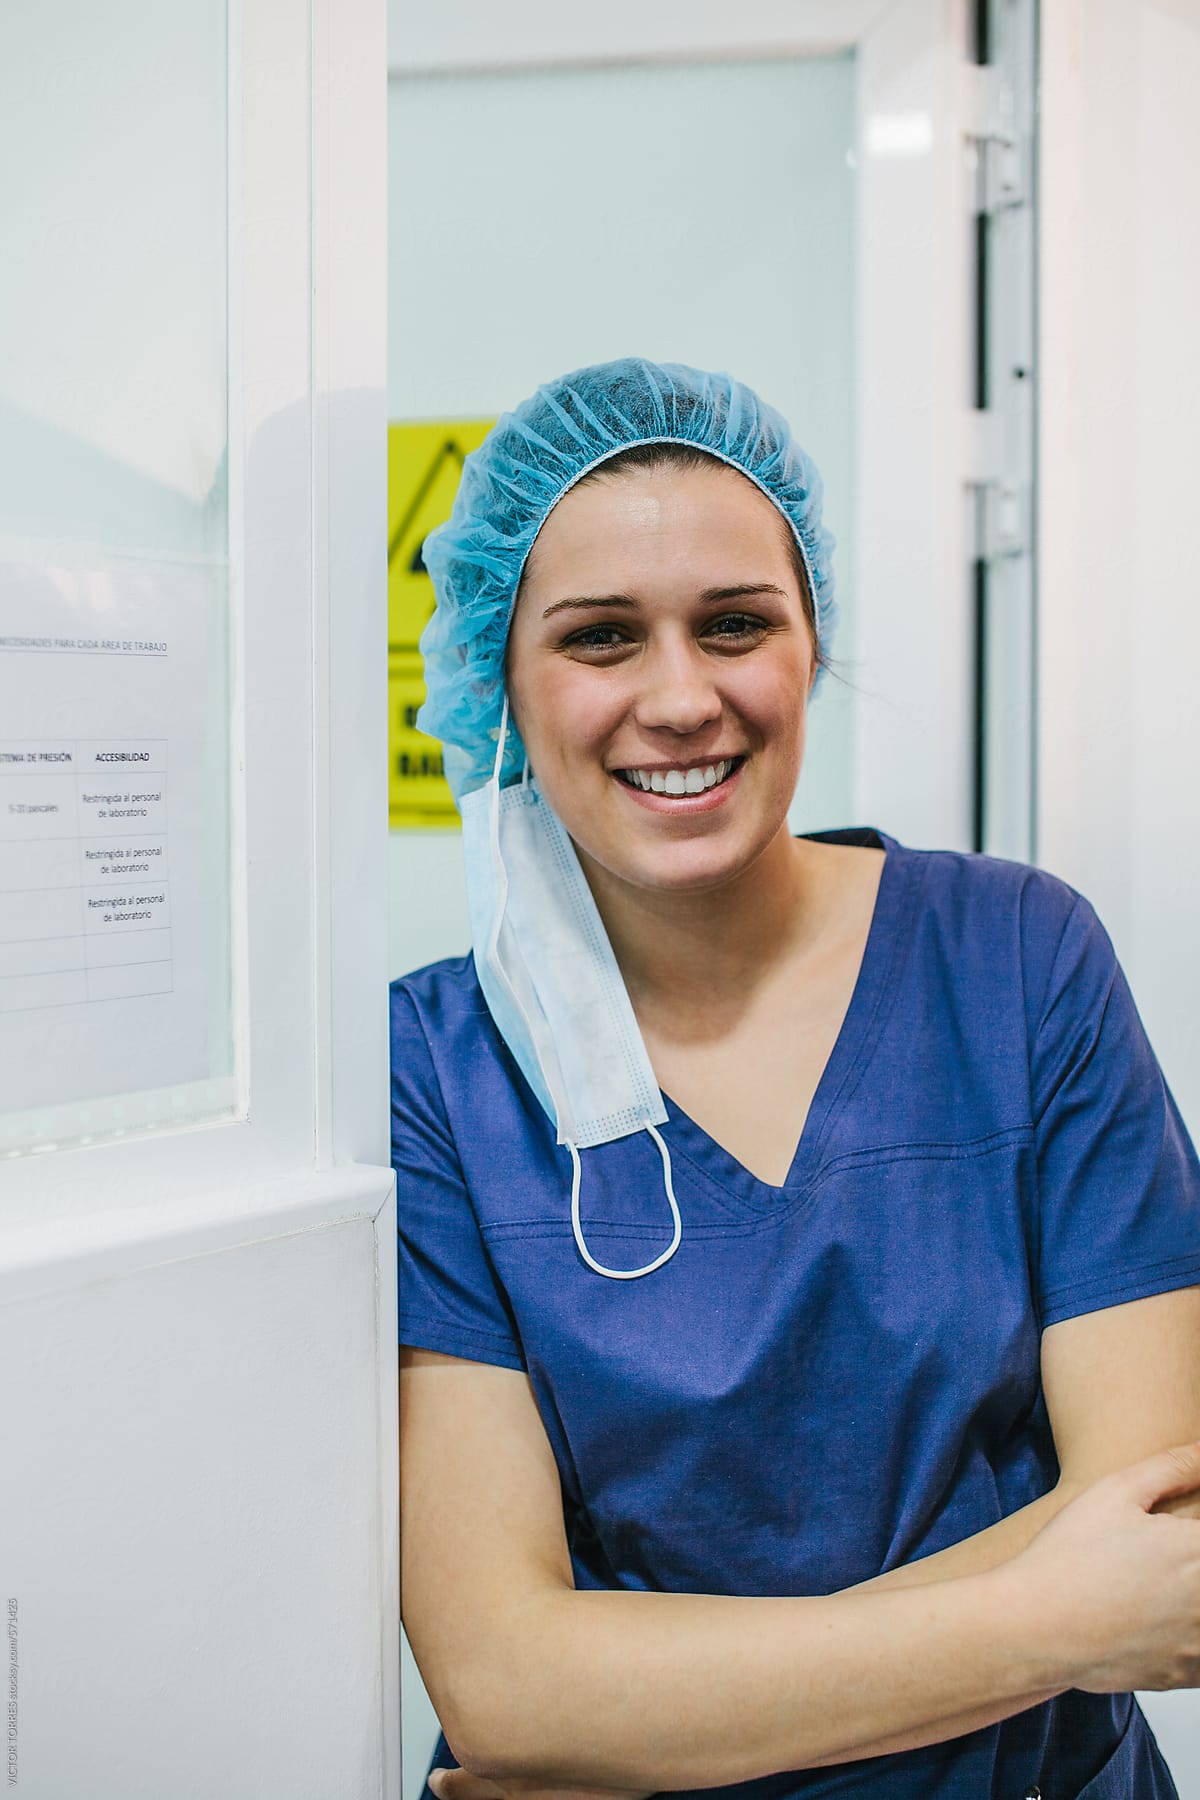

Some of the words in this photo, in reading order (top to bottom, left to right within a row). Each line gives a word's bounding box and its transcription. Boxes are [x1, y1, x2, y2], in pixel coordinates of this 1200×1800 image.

[55, 639, 75, 648] PARA
[77, 639, 99, 649] CADA
[122, 640, 133, 651] DE
[134, 641, 168, 652] TRABAJO
[27, 753, 37, 763] DE
[39, 752, 72, 762] PRESIÓN
[95, 752, 150, 762] ACCESIBILIDAD
[82, 794, 122, 805] Restringida
[124, 793, 130, 803] al
[131, 792, 162, 804] personal
[98, 810, 108, 818] de
[109, 808, 148, 818] laboratorio
[85, 850, 124, 860] Restringida
[125, 849, 132, 858] al
[133, 847, 162, 860] personal
[100, 865, 110, 874] de
[111, 862, 149, 873] laboratorio
[88, 897, 126, 908] Restringida
[128, 896, 135, 905] al
[135, 893, 165, 906] personal
[103, 914, 113, 922] de
[114, 910, 152, 921] laboratorio
